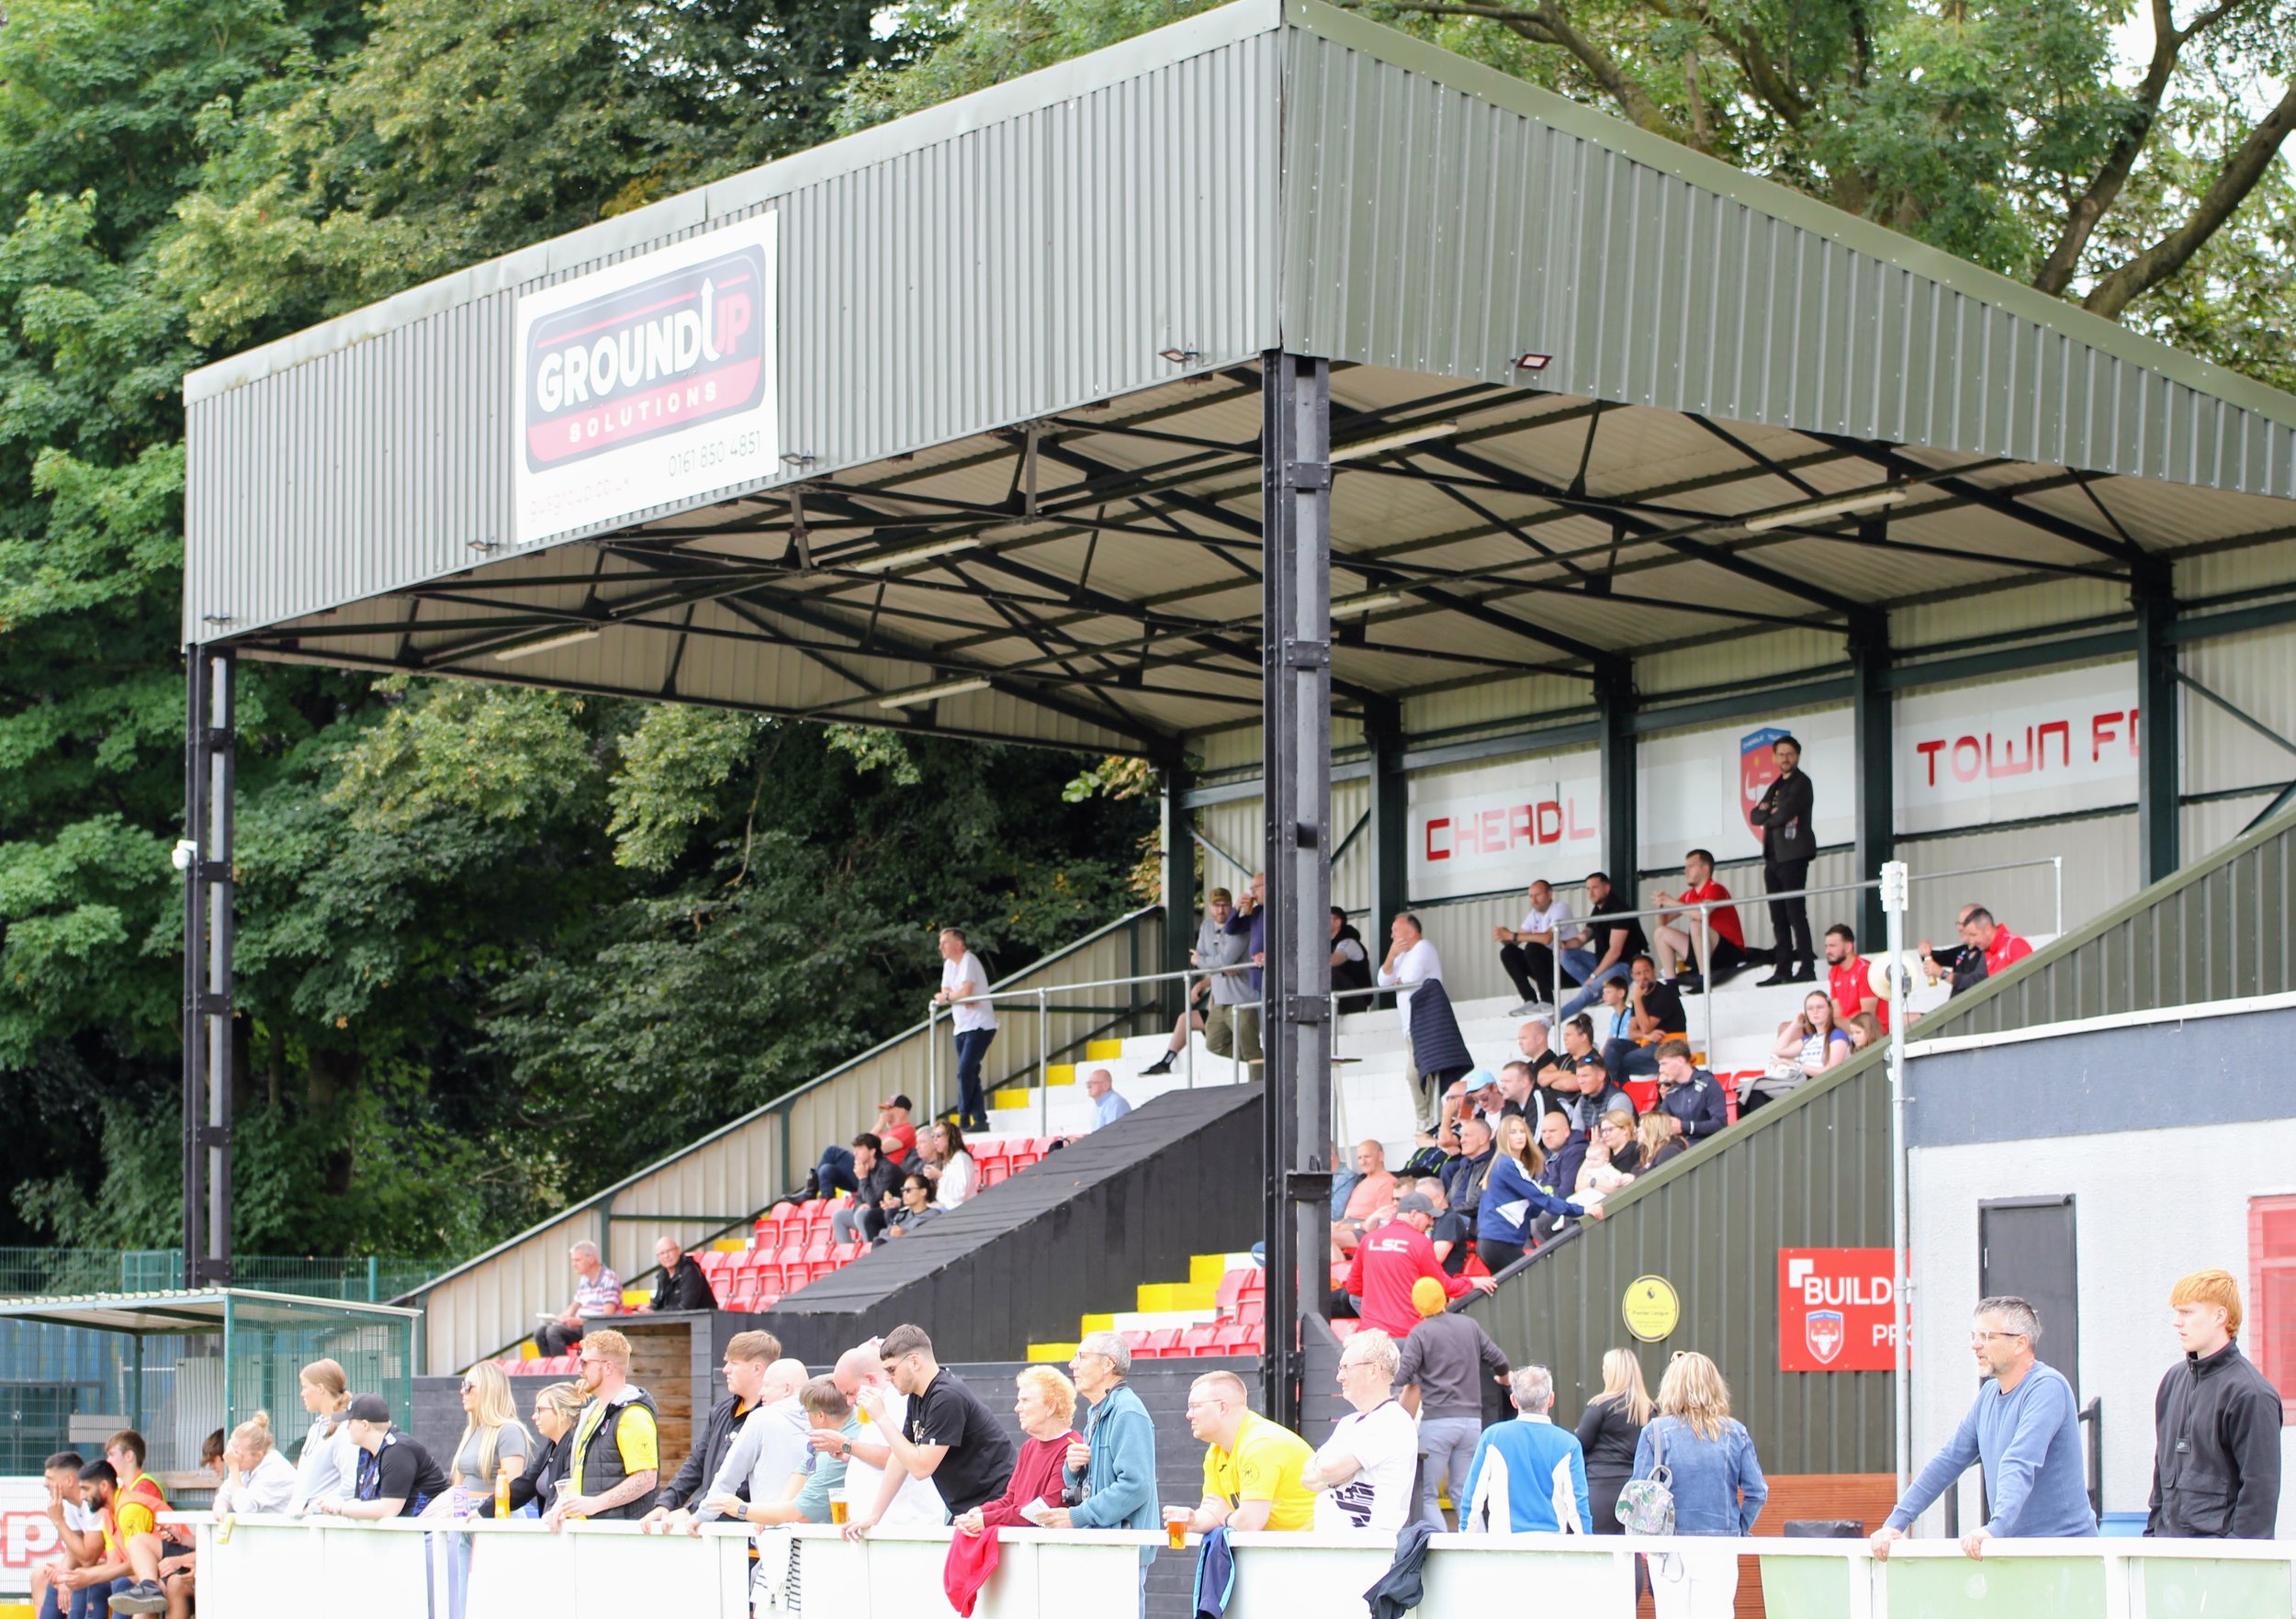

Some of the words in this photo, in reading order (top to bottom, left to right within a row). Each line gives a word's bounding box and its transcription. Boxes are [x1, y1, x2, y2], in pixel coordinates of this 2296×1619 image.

[568, 380, 717, 444] SOLUTIONS
[668, 448, 695, 478] 0161
[700, 440, 725, 468] 850
[729, 429, 761, 458] 4851
[1917, 720, 2069, 787] TOWN
[1426, 794, 1604, 862] CHEADL
[1368, 1239, 1409, 1254] LSC
